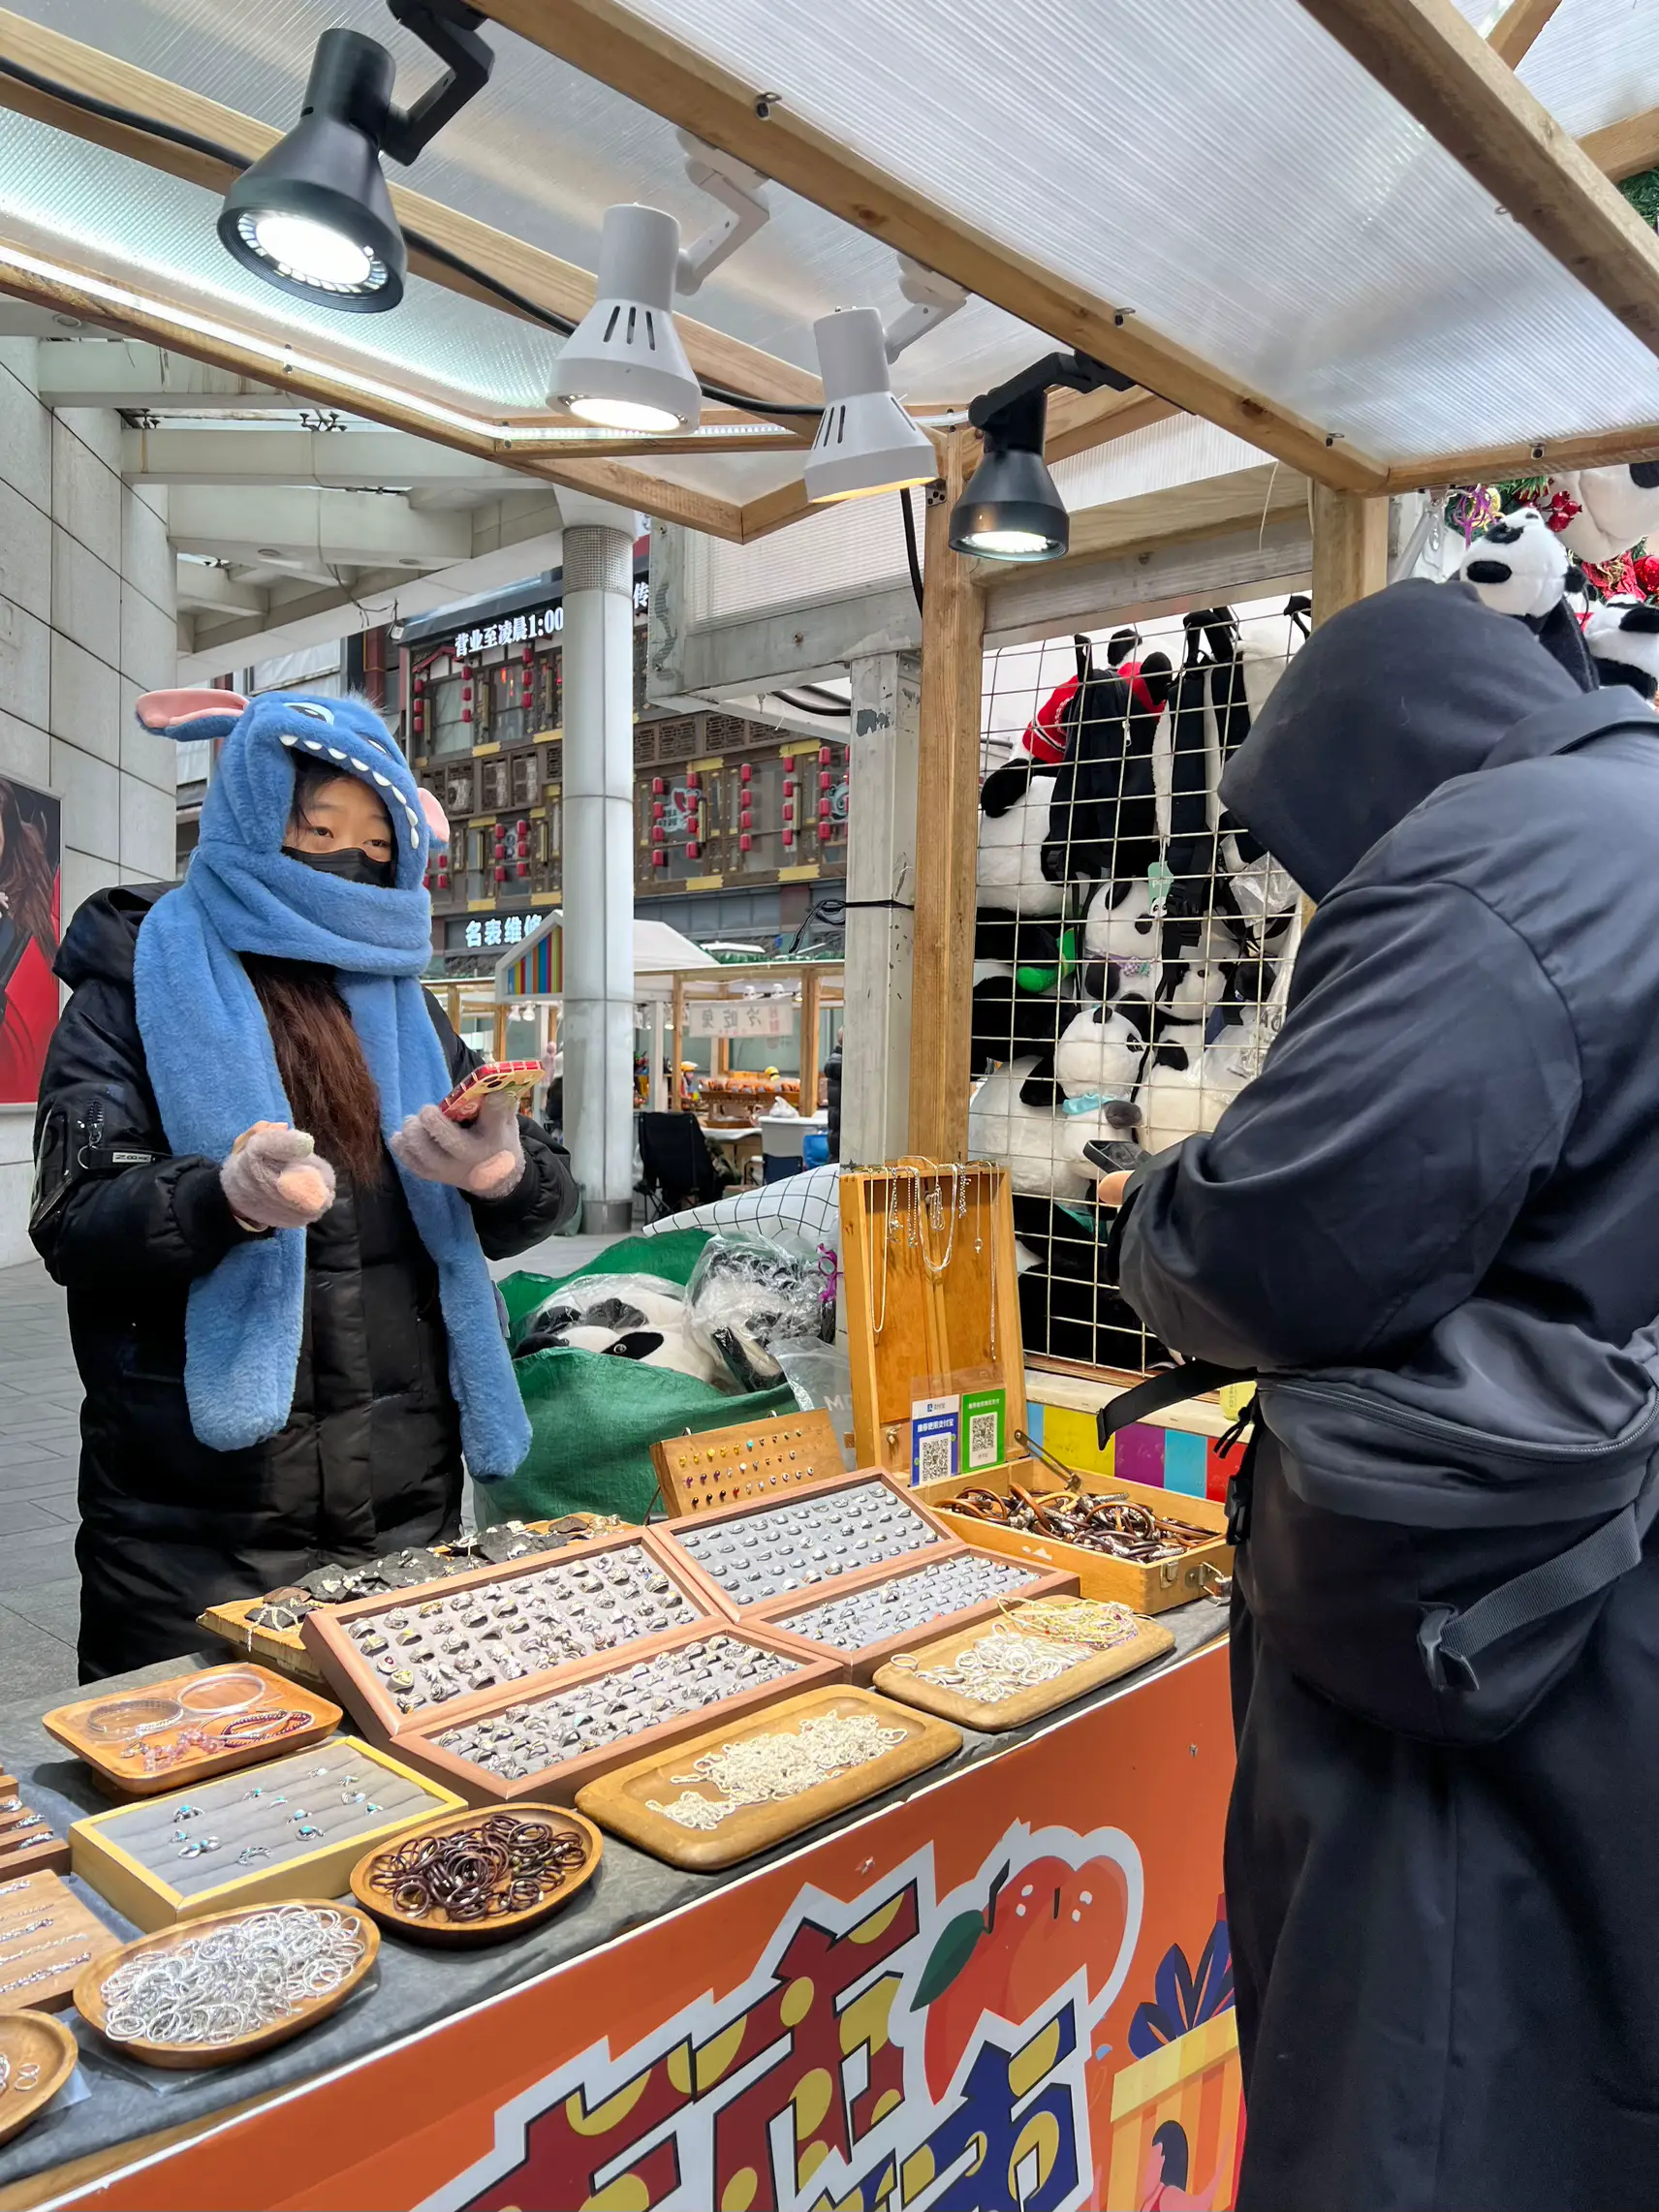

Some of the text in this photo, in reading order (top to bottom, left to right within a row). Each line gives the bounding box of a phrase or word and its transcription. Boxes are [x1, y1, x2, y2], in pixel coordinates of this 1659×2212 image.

[455, 607, 564, 658] 营业至凌晨1:00
